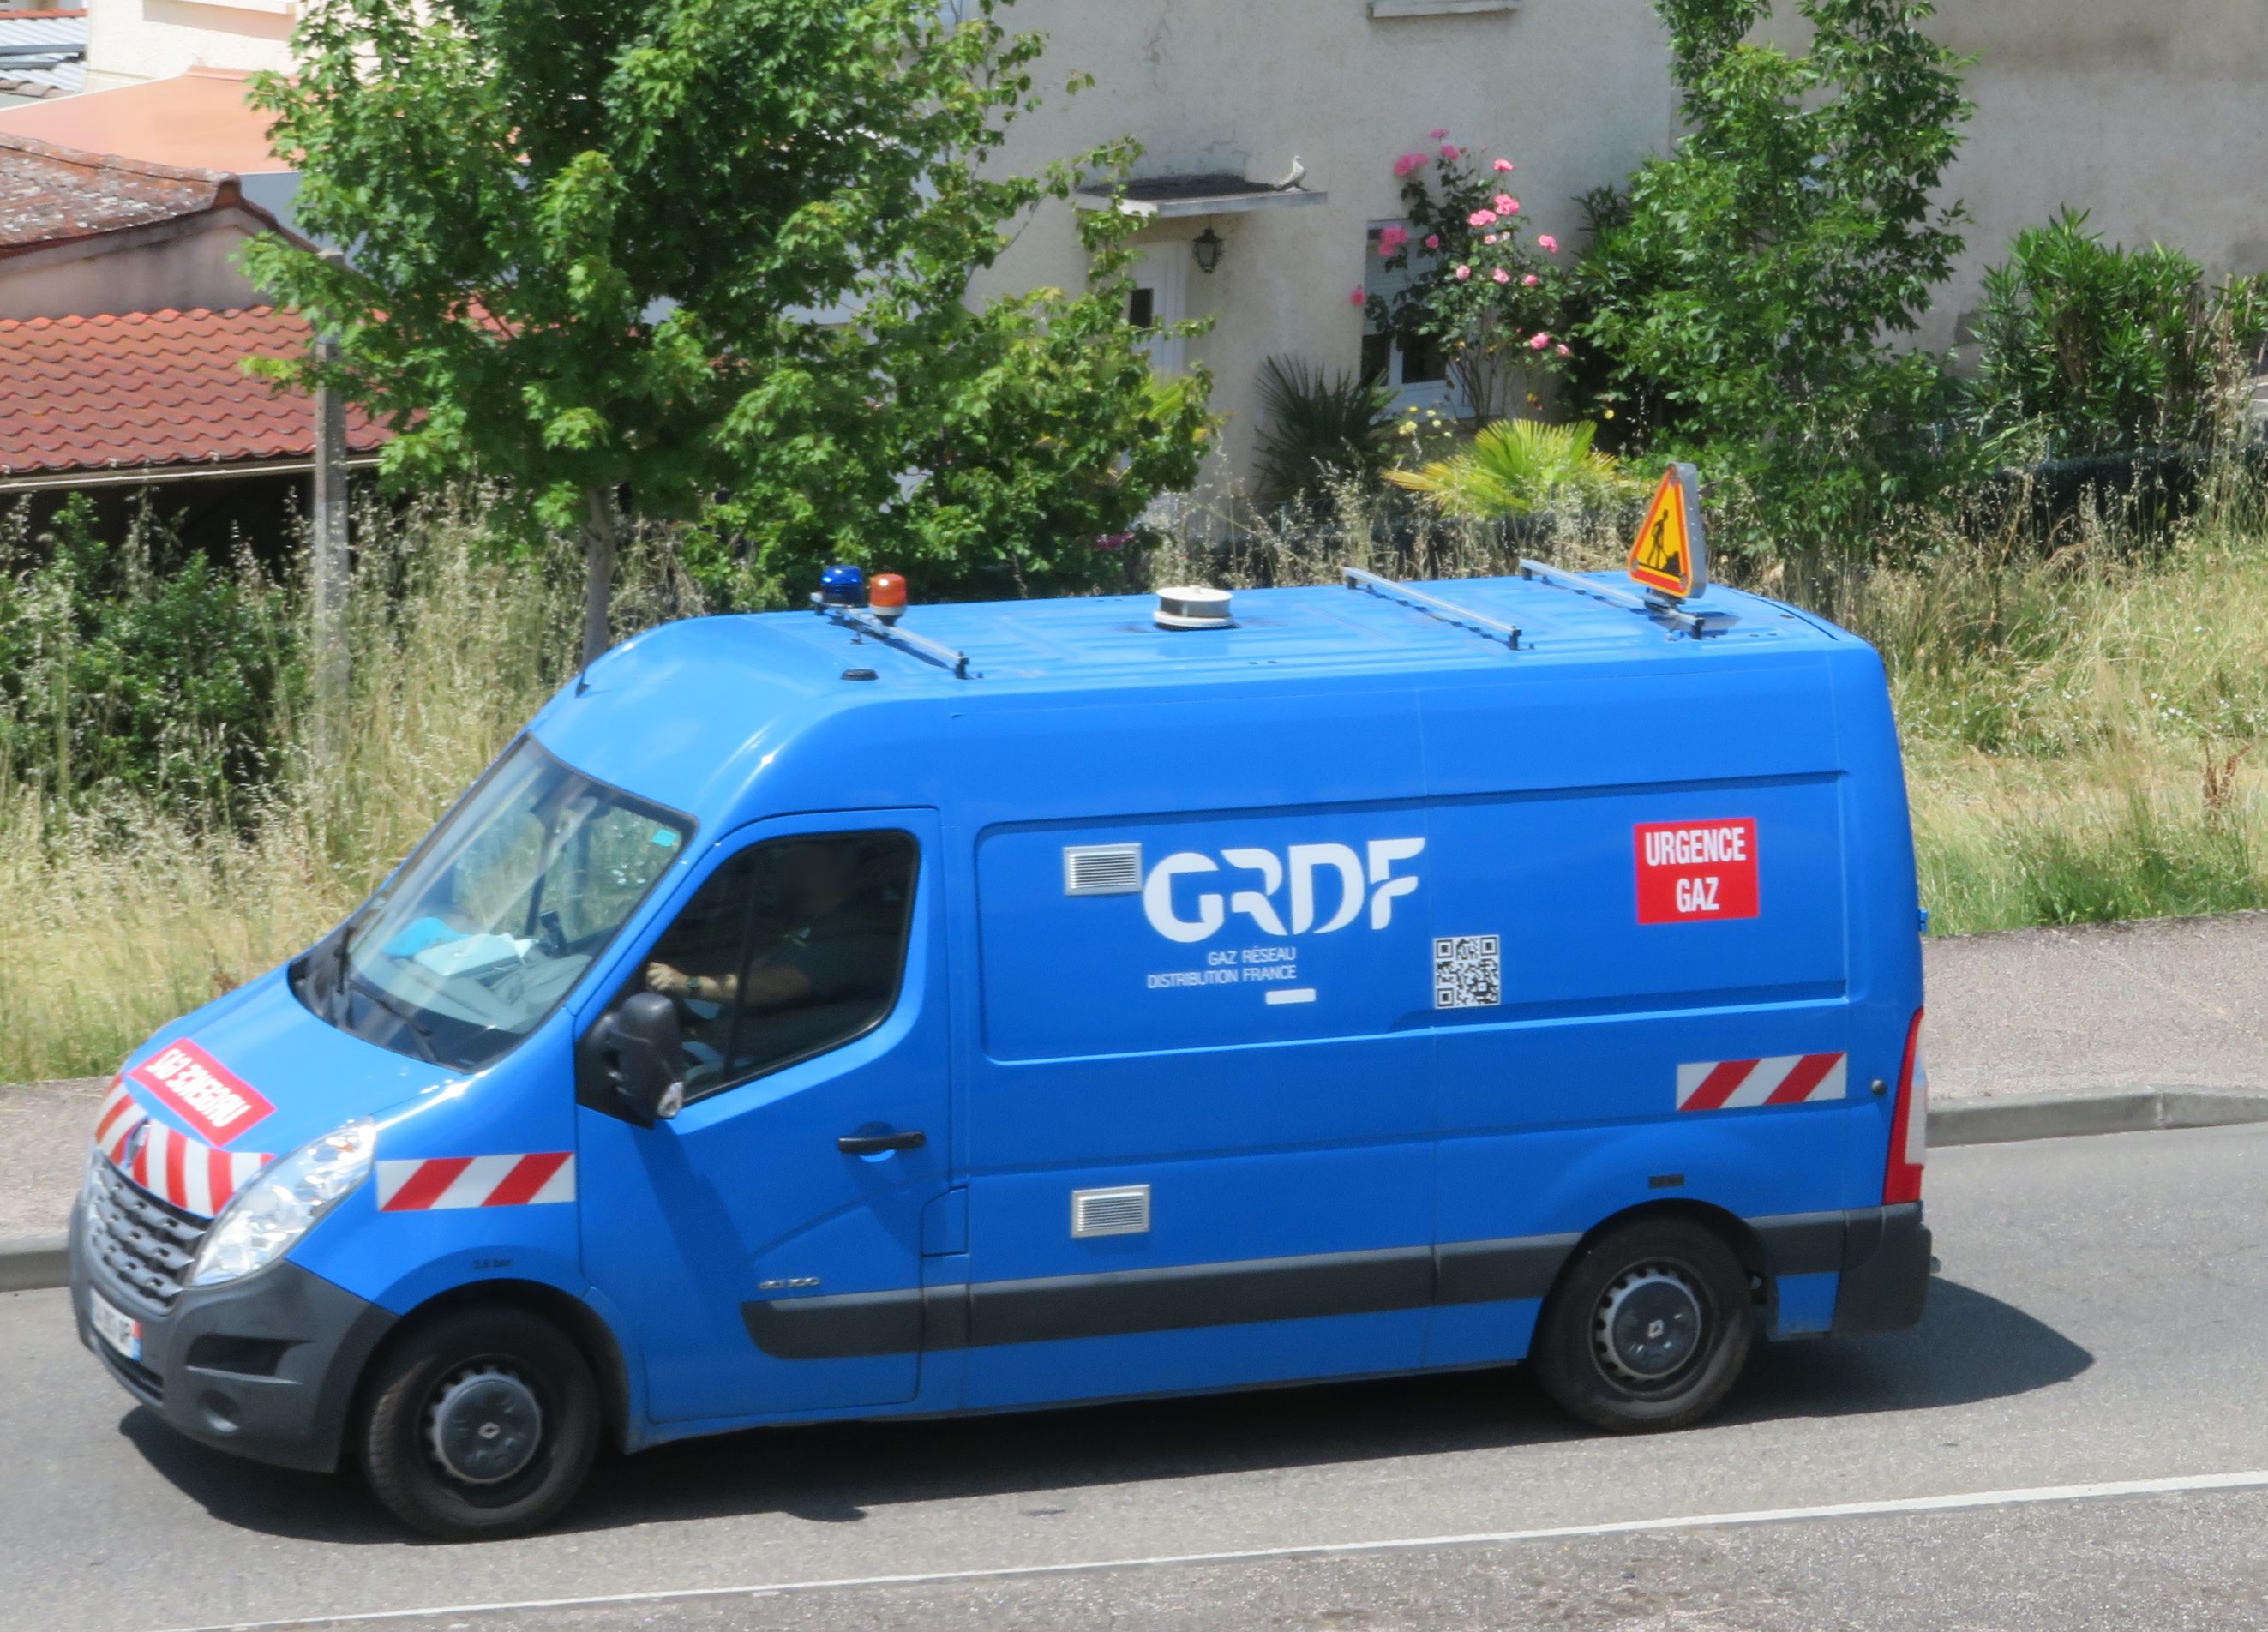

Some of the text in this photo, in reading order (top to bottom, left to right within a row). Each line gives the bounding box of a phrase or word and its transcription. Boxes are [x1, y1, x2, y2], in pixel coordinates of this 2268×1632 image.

[1645, 827, 1747, 867] URGENCE
[1143, 837, 1426, 943] GRDF
[1676, 877, 1719, 913] GAZ
[1208, 951, 1238, 966] GAZ
[1147, 965, 1297, 989] DISTRIBUTION FRANCE
